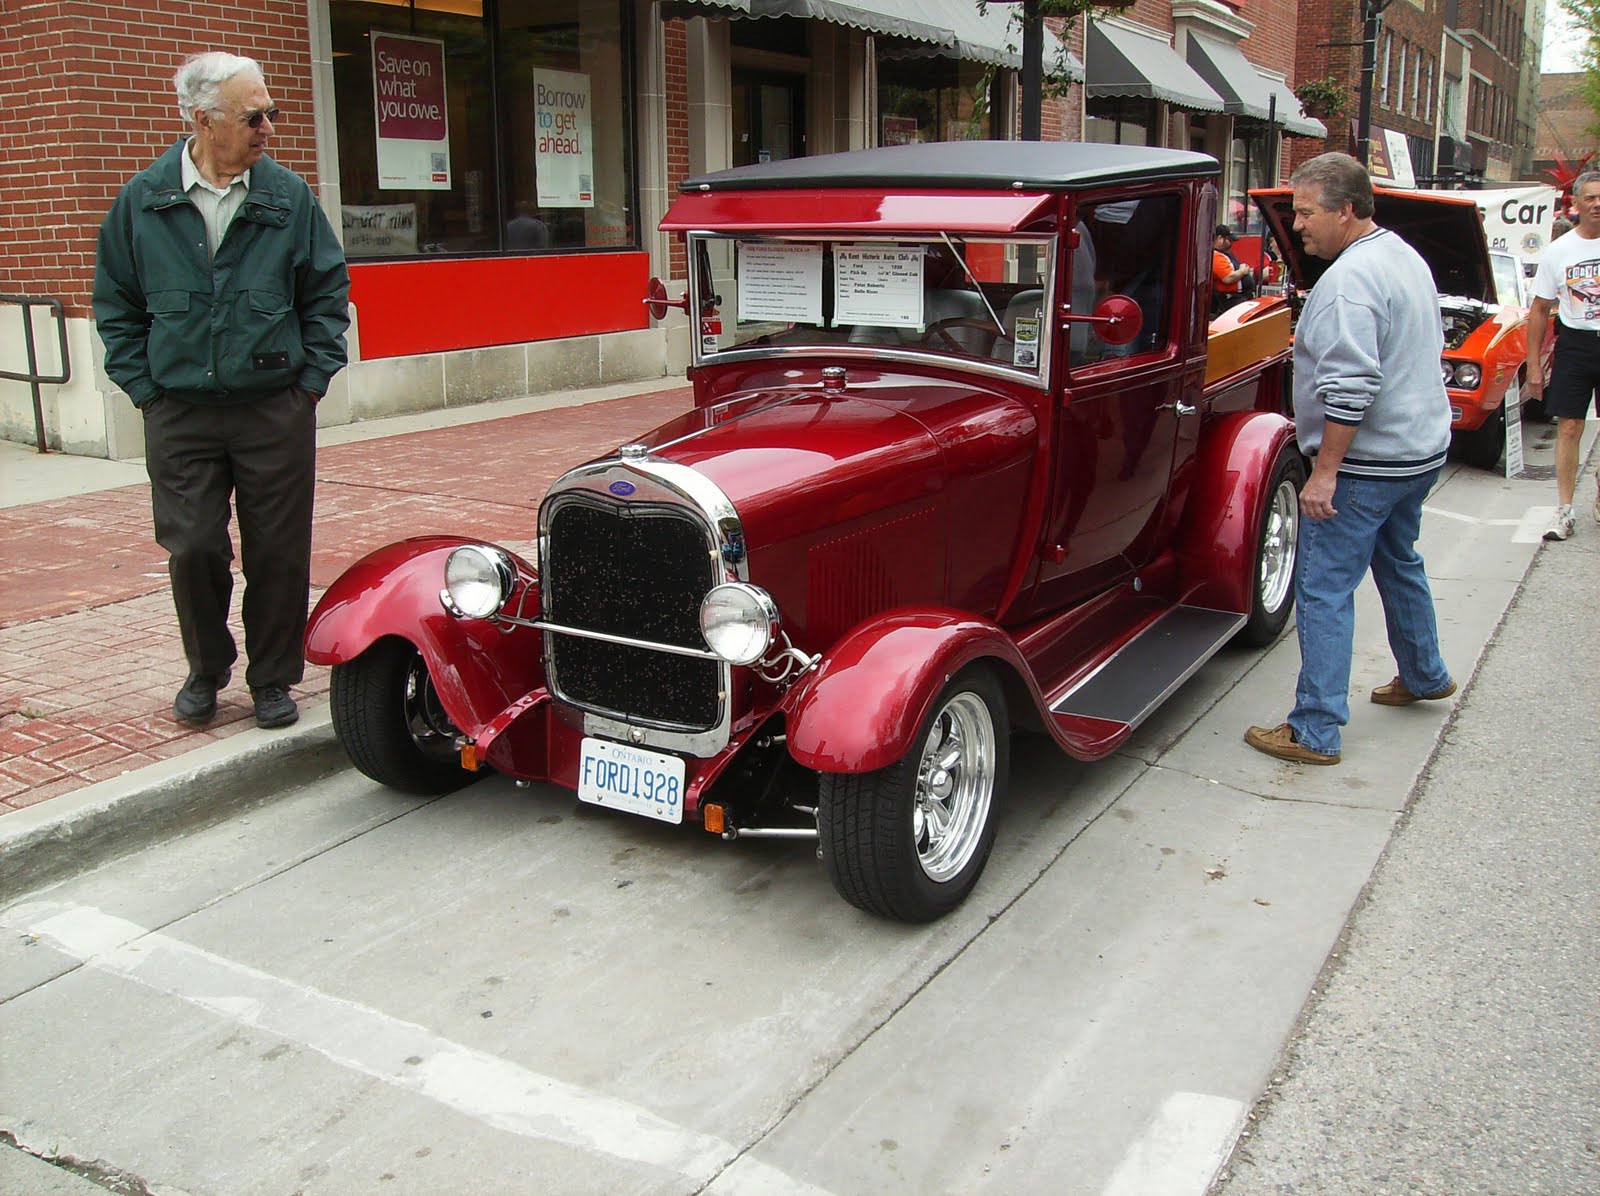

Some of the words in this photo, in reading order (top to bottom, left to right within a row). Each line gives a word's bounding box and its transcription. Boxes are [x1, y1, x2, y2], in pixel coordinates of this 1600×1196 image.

[378, 51, 411, 75] Save
[413, 60, 431, 77] on
[379, 74, 417, 98] what
[537, 83, 586, 109] Borrow
[380, 101, 406, 122] you
[408, 103, 442, 120] owe.
[537, 108, 553, 128] to
[555, 110, 577, 135] get
[539, 130, 582, 154] ahead.
[1501, 199, 1548, 225] Car
[898, 253, 910, 261] Club
[1567, 265, 1600, 279] CORVE
[612, 748, 652, 765] ONTARIO
[583, 755, 679, 806] FORD1928
